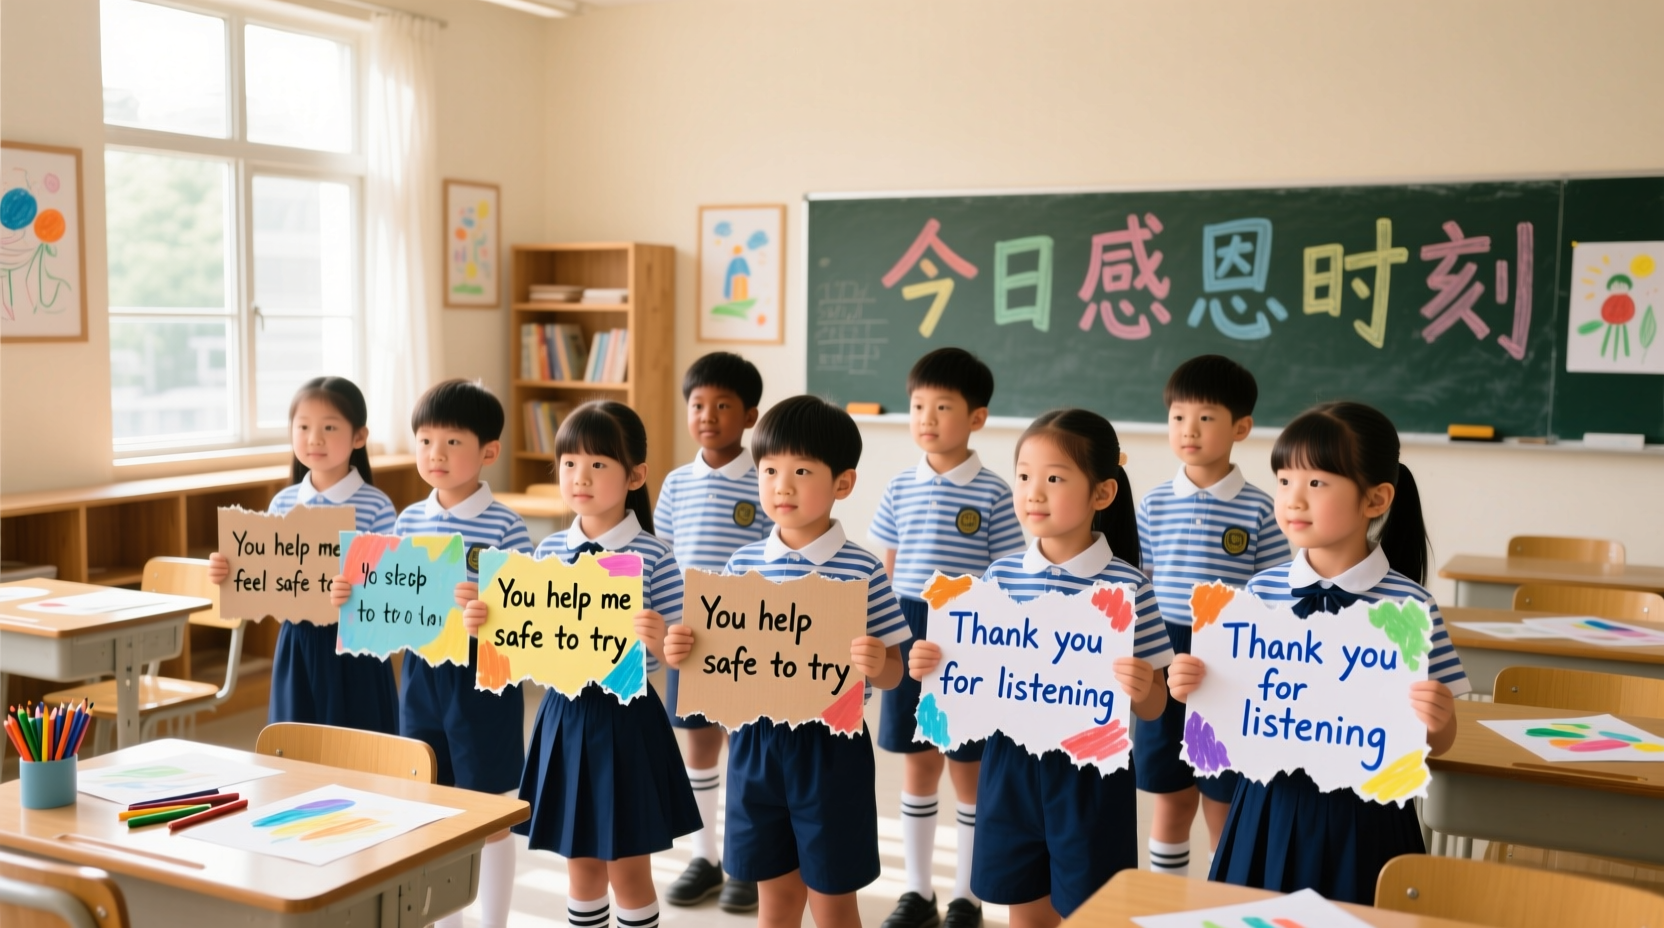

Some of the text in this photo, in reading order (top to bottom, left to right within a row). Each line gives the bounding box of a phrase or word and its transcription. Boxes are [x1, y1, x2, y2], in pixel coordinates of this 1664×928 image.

[881, 212, 1534, 361] 今日感恩时刻
[232, 530, 266, 557] You
[274, 532, 310, 565] help
[233, 568, 267, 592] feel
[275, 569, 310, 598] safe
[497, 577, 632, 621] You help me
[494, 620, 628, 665] safe to try
[700, 594, 813, 646] You help
[948, 610, 1104, 665] Thank you
[702, 645, 851, 696] safe to try
[1222, 621, 1399, 683] Thank you
[938, 660, 1115, 726] for listening
[1256, 666, 1309, 702] for
[1240, 698, 1387, 773] listening
